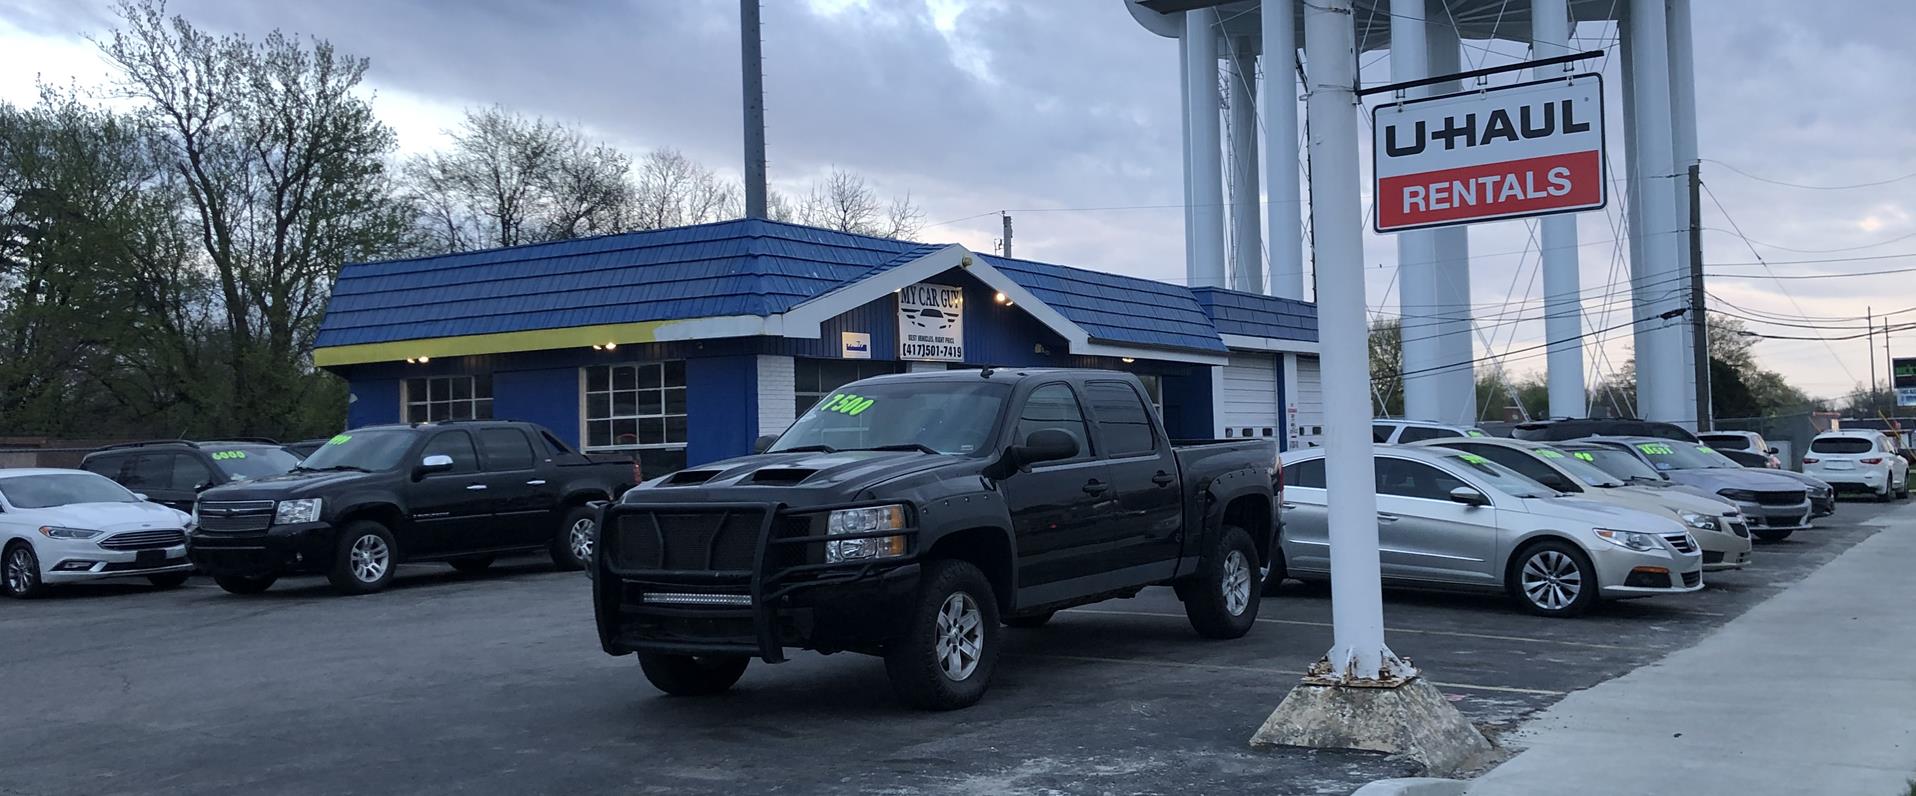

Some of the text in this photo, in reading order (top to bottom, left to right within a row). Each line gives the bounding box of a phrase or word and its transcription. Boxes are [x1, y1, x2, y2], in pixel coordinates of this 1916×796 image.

[1385, 99, 1590, 158] U-HAUL
[1402, 166, 1572, 214] RENTALS
[901, 286, 960, 308] MY CAR GUY
[821, 393, 874, 416] 7500
[211, 450, 246, 460] 6000
